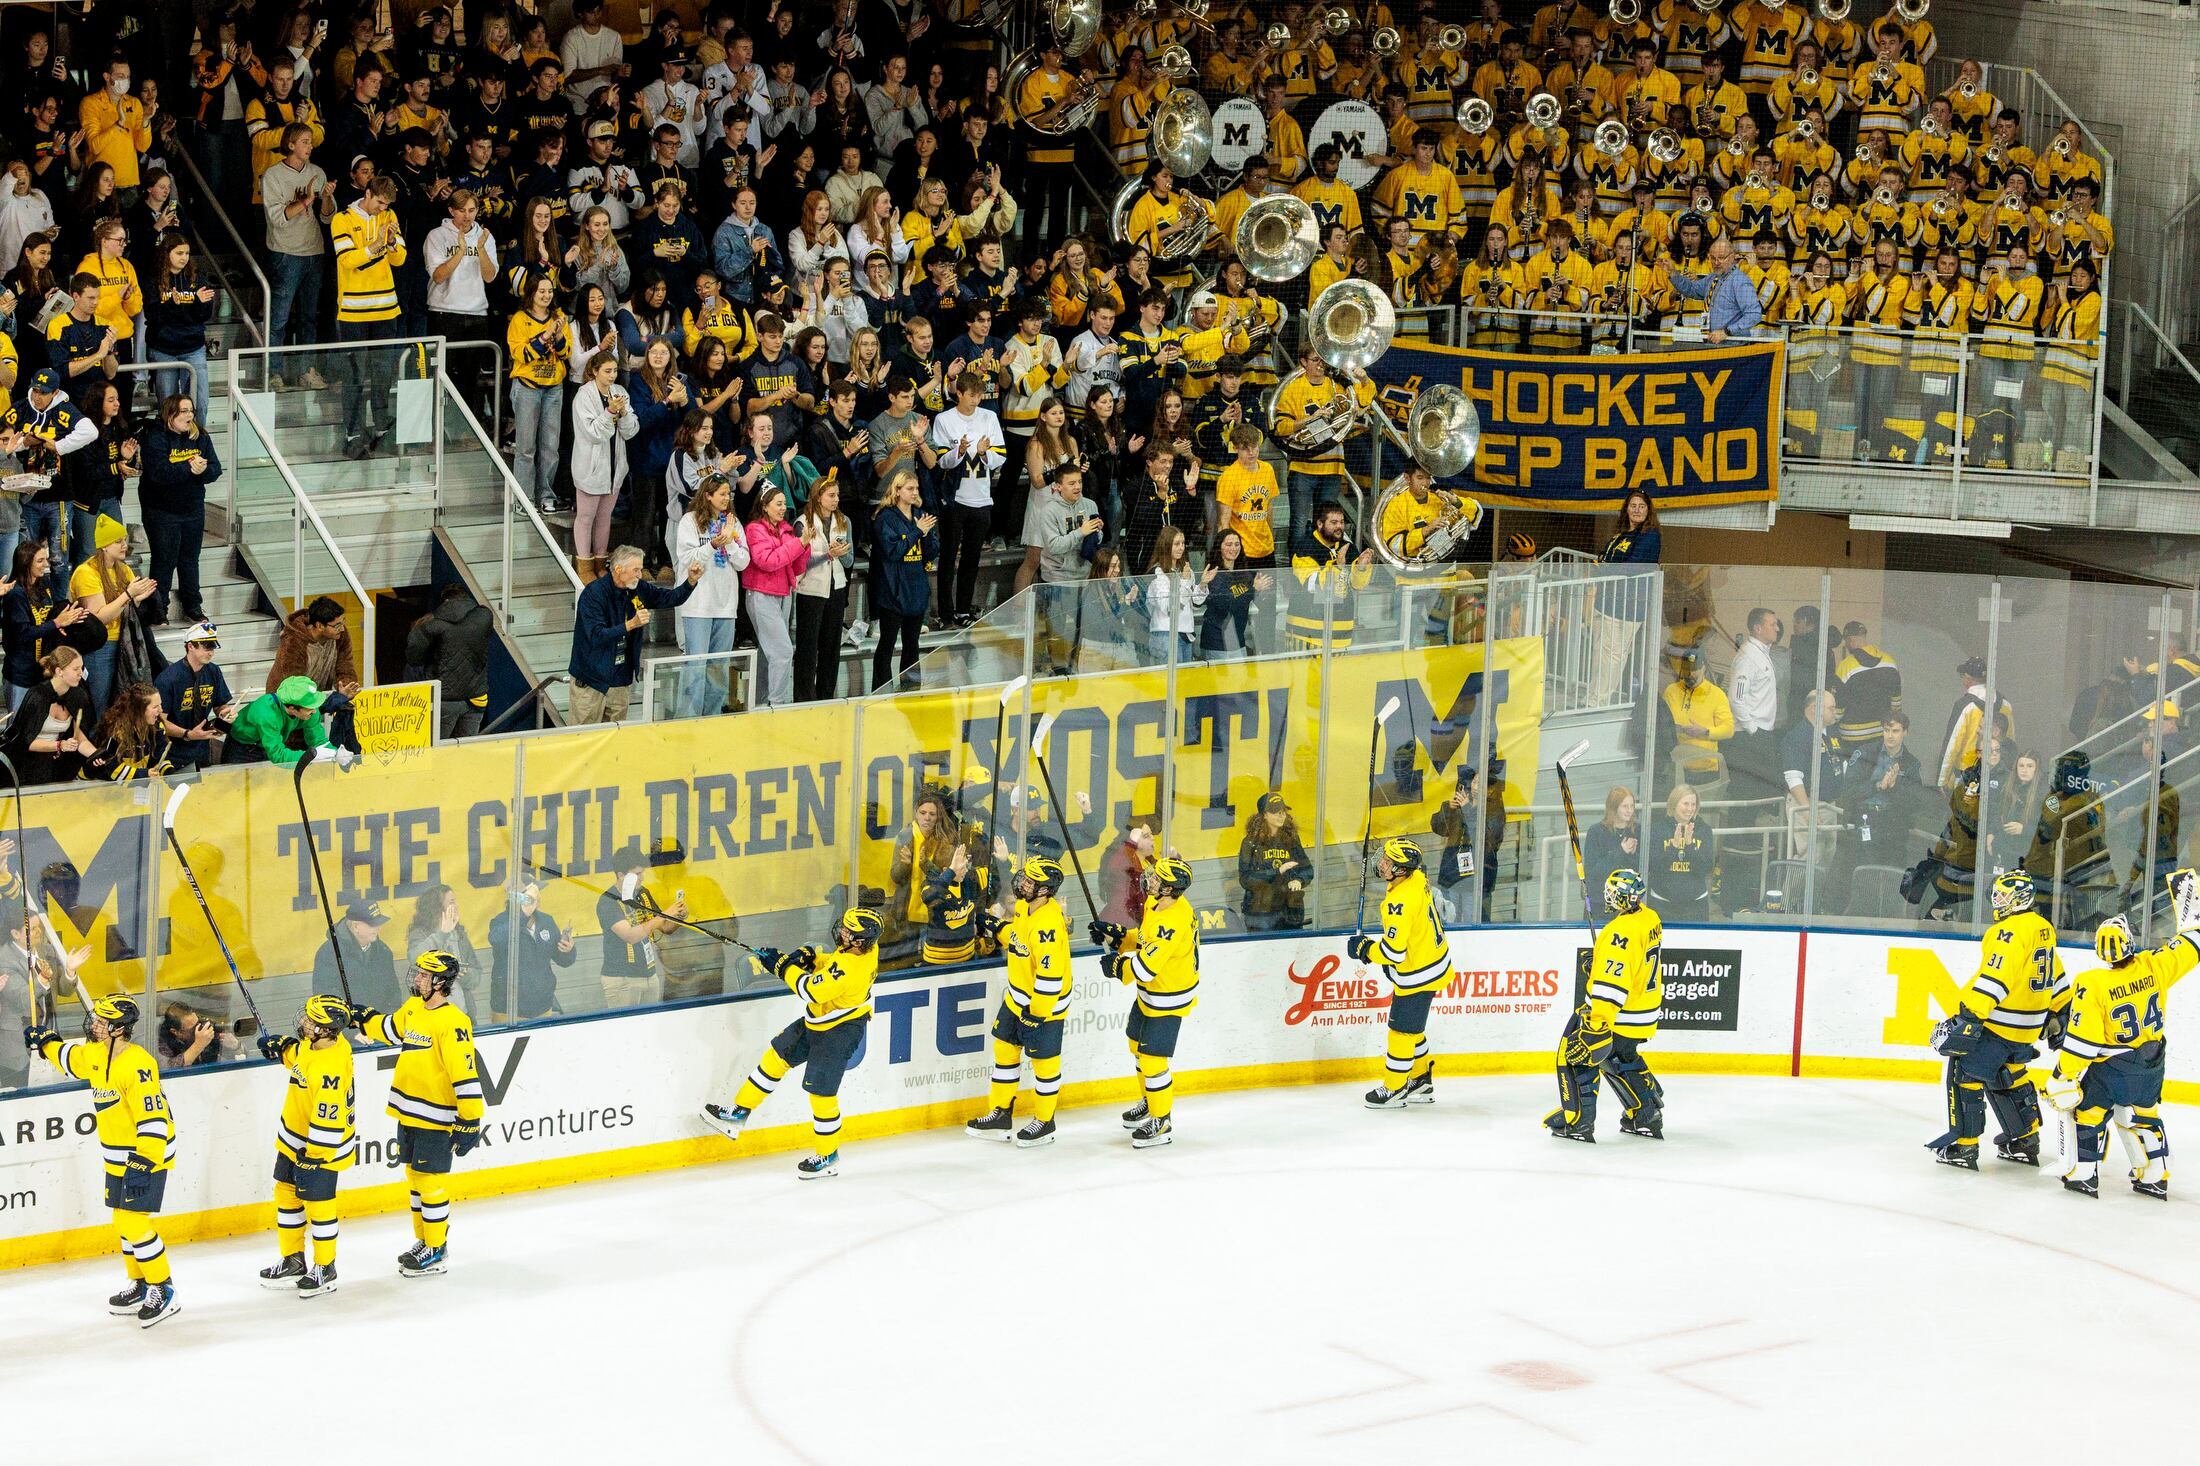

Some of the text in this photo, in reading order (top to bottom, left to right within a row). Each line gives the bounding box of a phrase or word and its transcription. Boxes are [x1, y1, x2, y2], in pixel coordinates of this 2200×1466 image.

[1678, 24, 1709, 51] M
[1755, 24, 1789, 55] M
[1415, 65, 1449, 93] M
[1869, 80, 1898, 106] M
[1222, 123, 1250, 146] M
[1952, 114, 1984, 141] M
[1331, 131, 1365, 159] M
[1455, 150, 1488, 176] M
[1312, 201, 1343, 227] M
[1404, 192, 1438, 221] M
[1739, 203, 1774, 231] M
[1806, 226, 1837, 252] M
[1462, 367, 1732, 427] HOCKEY
[1475, 428, 1757, 489] EP BAND
[1241, 485, 1270, 505] MICHIGA
[1251, 498, 1263, 511] M
[355, 713, 426, 738] onner!
[277, 806, 440, 912] THE
[468, 761, 842, 890] CHILDREN
[866, 750, 951, 842] OF
[1372, 670, 1510, 808] M
[1029, 790, 1039, 799] M
[1263, 848, 1290, 859] ICHIGA
[184, 866, 206, 906] BAUER
[1388, 903, 1404, 915] M
[2182, 883, 2195, 922] BAUER
[1200, 910, 1226, 930] M
[1038, 929, 1056, 944] M
[1157, 925, 1176, 941] M
[1611, 933, 1629, 950] M
[1997, 929, 2014, 944] M
[828, 961, 845, 981] M
[1041, 955, 1051, 969] 4
[1605, 959, 1624, 977] 72
[1682, 960, 1732, 978] Arbor
[1987, 953, 2004, 970] 31
[2029, 946, 2055, 992] 31
[812, 974, 824, 985] 5
[2108, 974, 2155, 1001] MOLINARO
[1285, 955, 1379, 1026] LEWIS
[1324, 1001, 1367, 1010] SINCE 1921
[1462, 1003, 1512, 1015] DIAMOND
[1311, 1011, 1390, 1028] Ann Arbor, M
[2110, 990, 2164, 1044] 34
[454, 1027, 470, 1042] M
[137, 1069, 153, 1083] M
[322, 1075, 340, 1090] M
[144, 1095, 163, 1112] 88
[318, 1103, 339, 1120] 92
[501, 1104, 634, 1143] ventures
